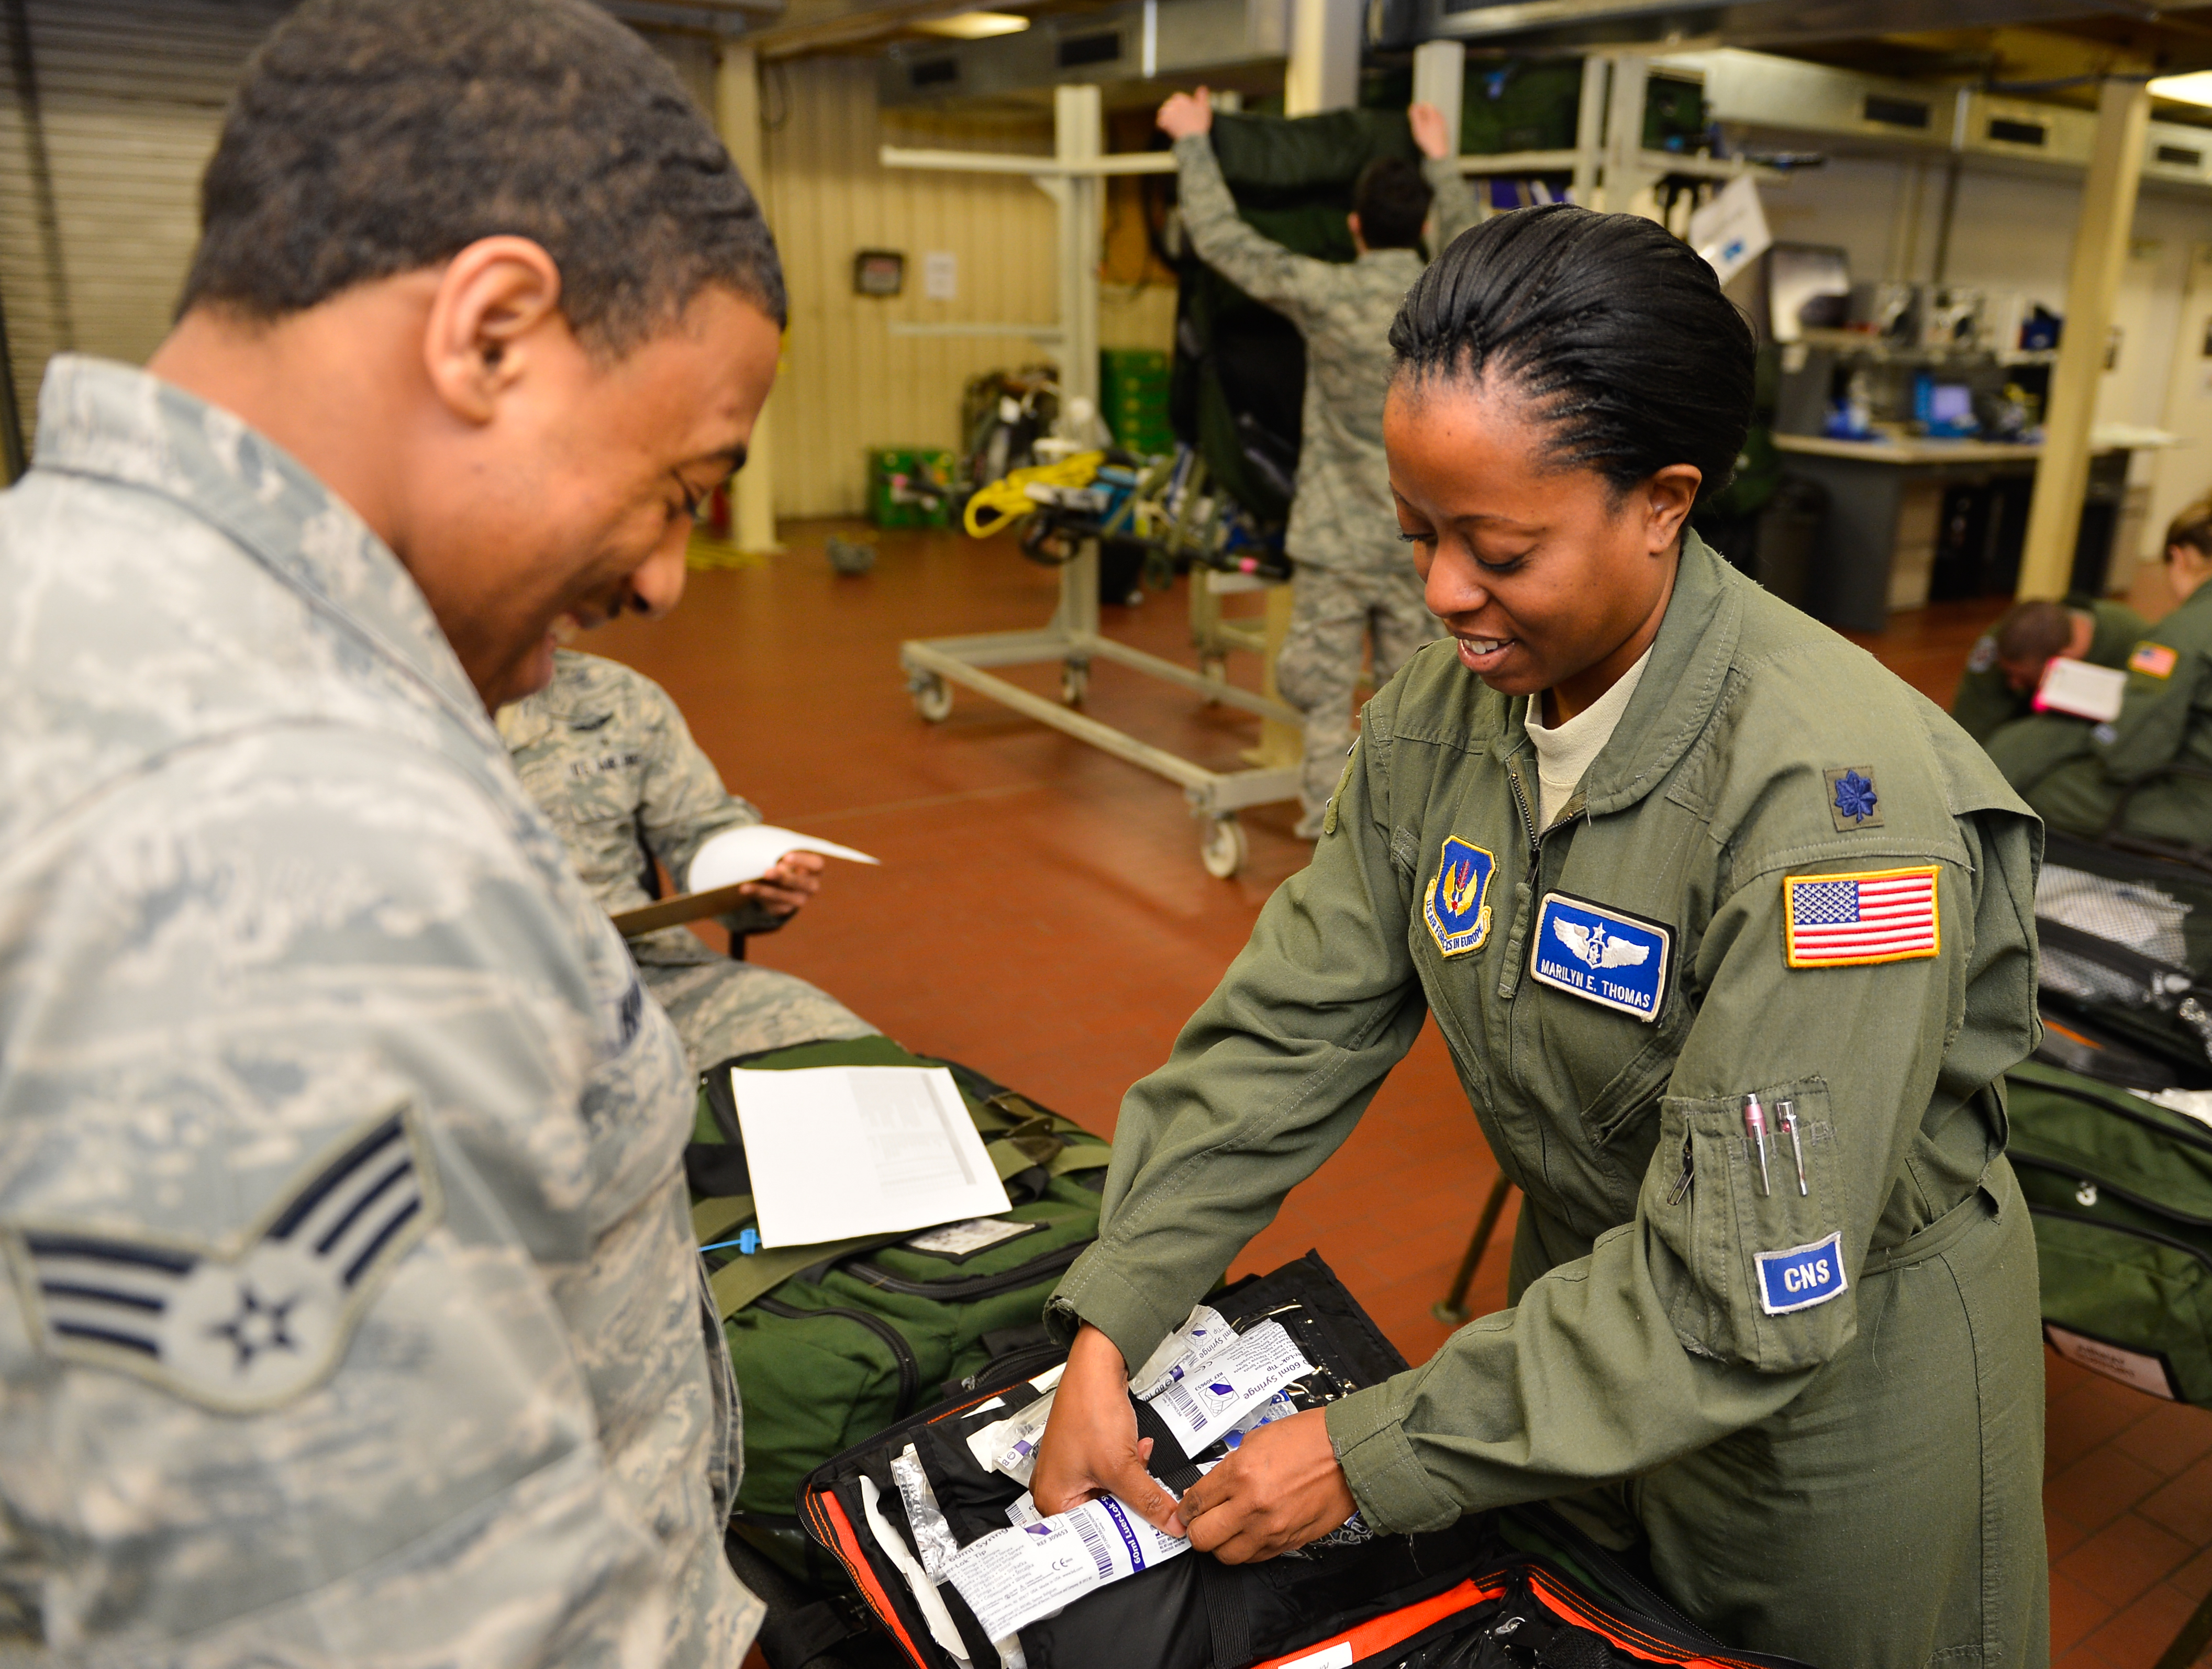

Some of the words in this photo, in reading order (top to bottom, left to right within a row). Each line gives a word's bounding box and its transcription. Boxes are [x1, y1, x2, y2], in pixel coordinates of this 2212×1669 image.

[1428, 914, 1437, 929] AIR
[1435, 925, 1452, 951] FORCES
[1453, 938, 1459, 949] IN
[1461, 923, 1483, 948] EUROPE
[1541, 959, 1583, 987] MARILYN
[1586, 975, 1597, 993] E.
[1601, 980, 1650, 1008] THOMAS
[1784, 1259, 1830, 1293] CNS
[1199, 1337, 1223, 1358] Syringe
[1278, 1362, 1300, 1377] 60ml
[1194, 1378, 1213, 1390] 309653
[1243, 1375, 1277, 1399] Syringe
[1048, 1529, 1068, 1542] 309653
[949, 1547, 974, 1563] 60ml
[975, 1550, 986, 1559] Tip
[1129, 1539, 1140, 1564] 60ml
